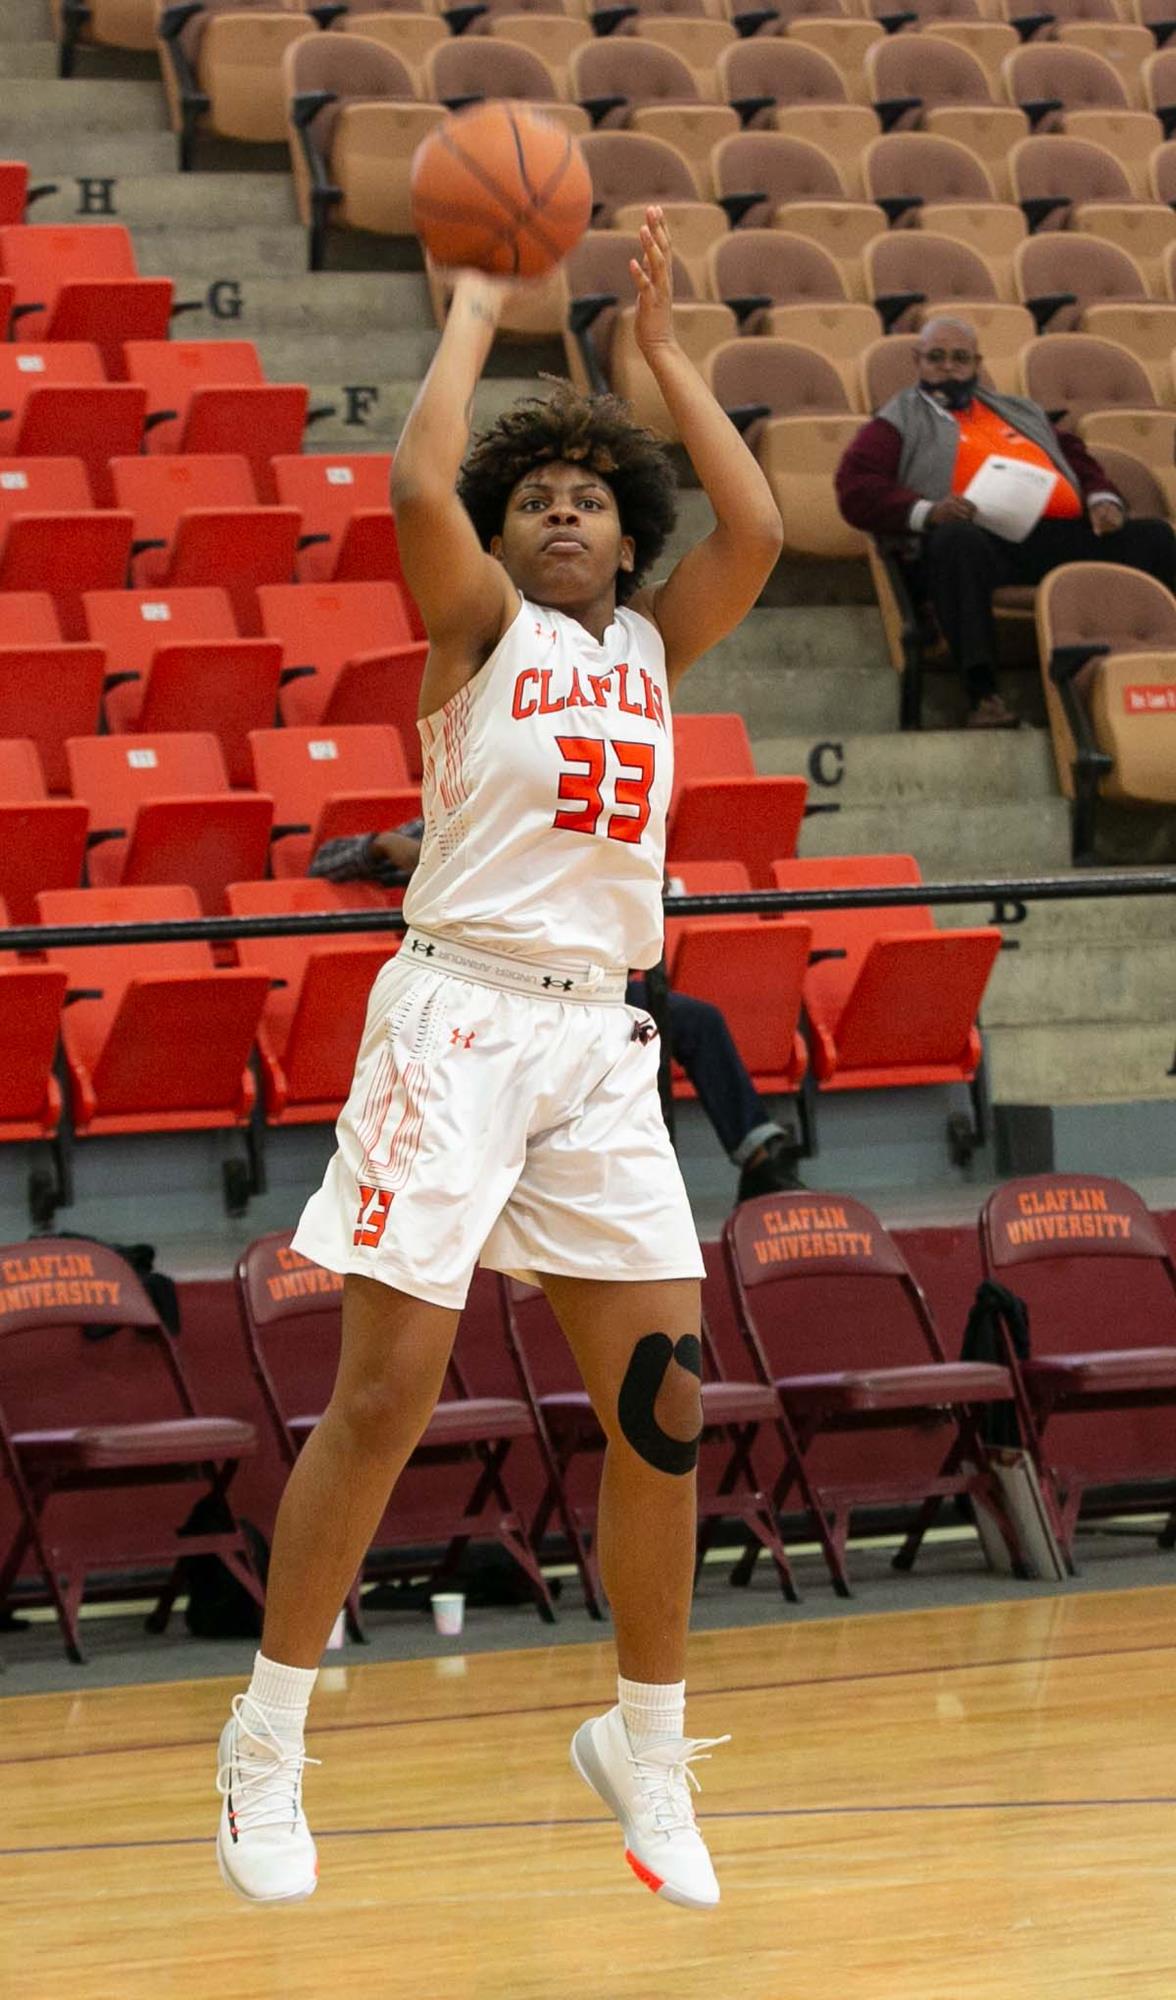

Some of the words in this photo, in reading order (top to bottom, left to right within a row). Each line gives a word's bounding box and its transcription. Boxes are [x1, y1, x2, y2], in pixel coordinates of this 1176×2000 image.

[77, 178, 117, 215] H
[208, 281, 243, 319] G
[342, 386, 378, 426] F
[808, 741, 844, 788] C
[552, 736, 656, 844] 33
[1018, 1188, 1108, 1217] CLAFLIN
[762, 1207, 849, 1235] CLAFLIN
[1006, 1213, 1131, 1245] UNIVERSITY
[752, 1232, 872, 1264] UNIVERSITY
[2, 1254, 94, 1284] CLAFLIN
